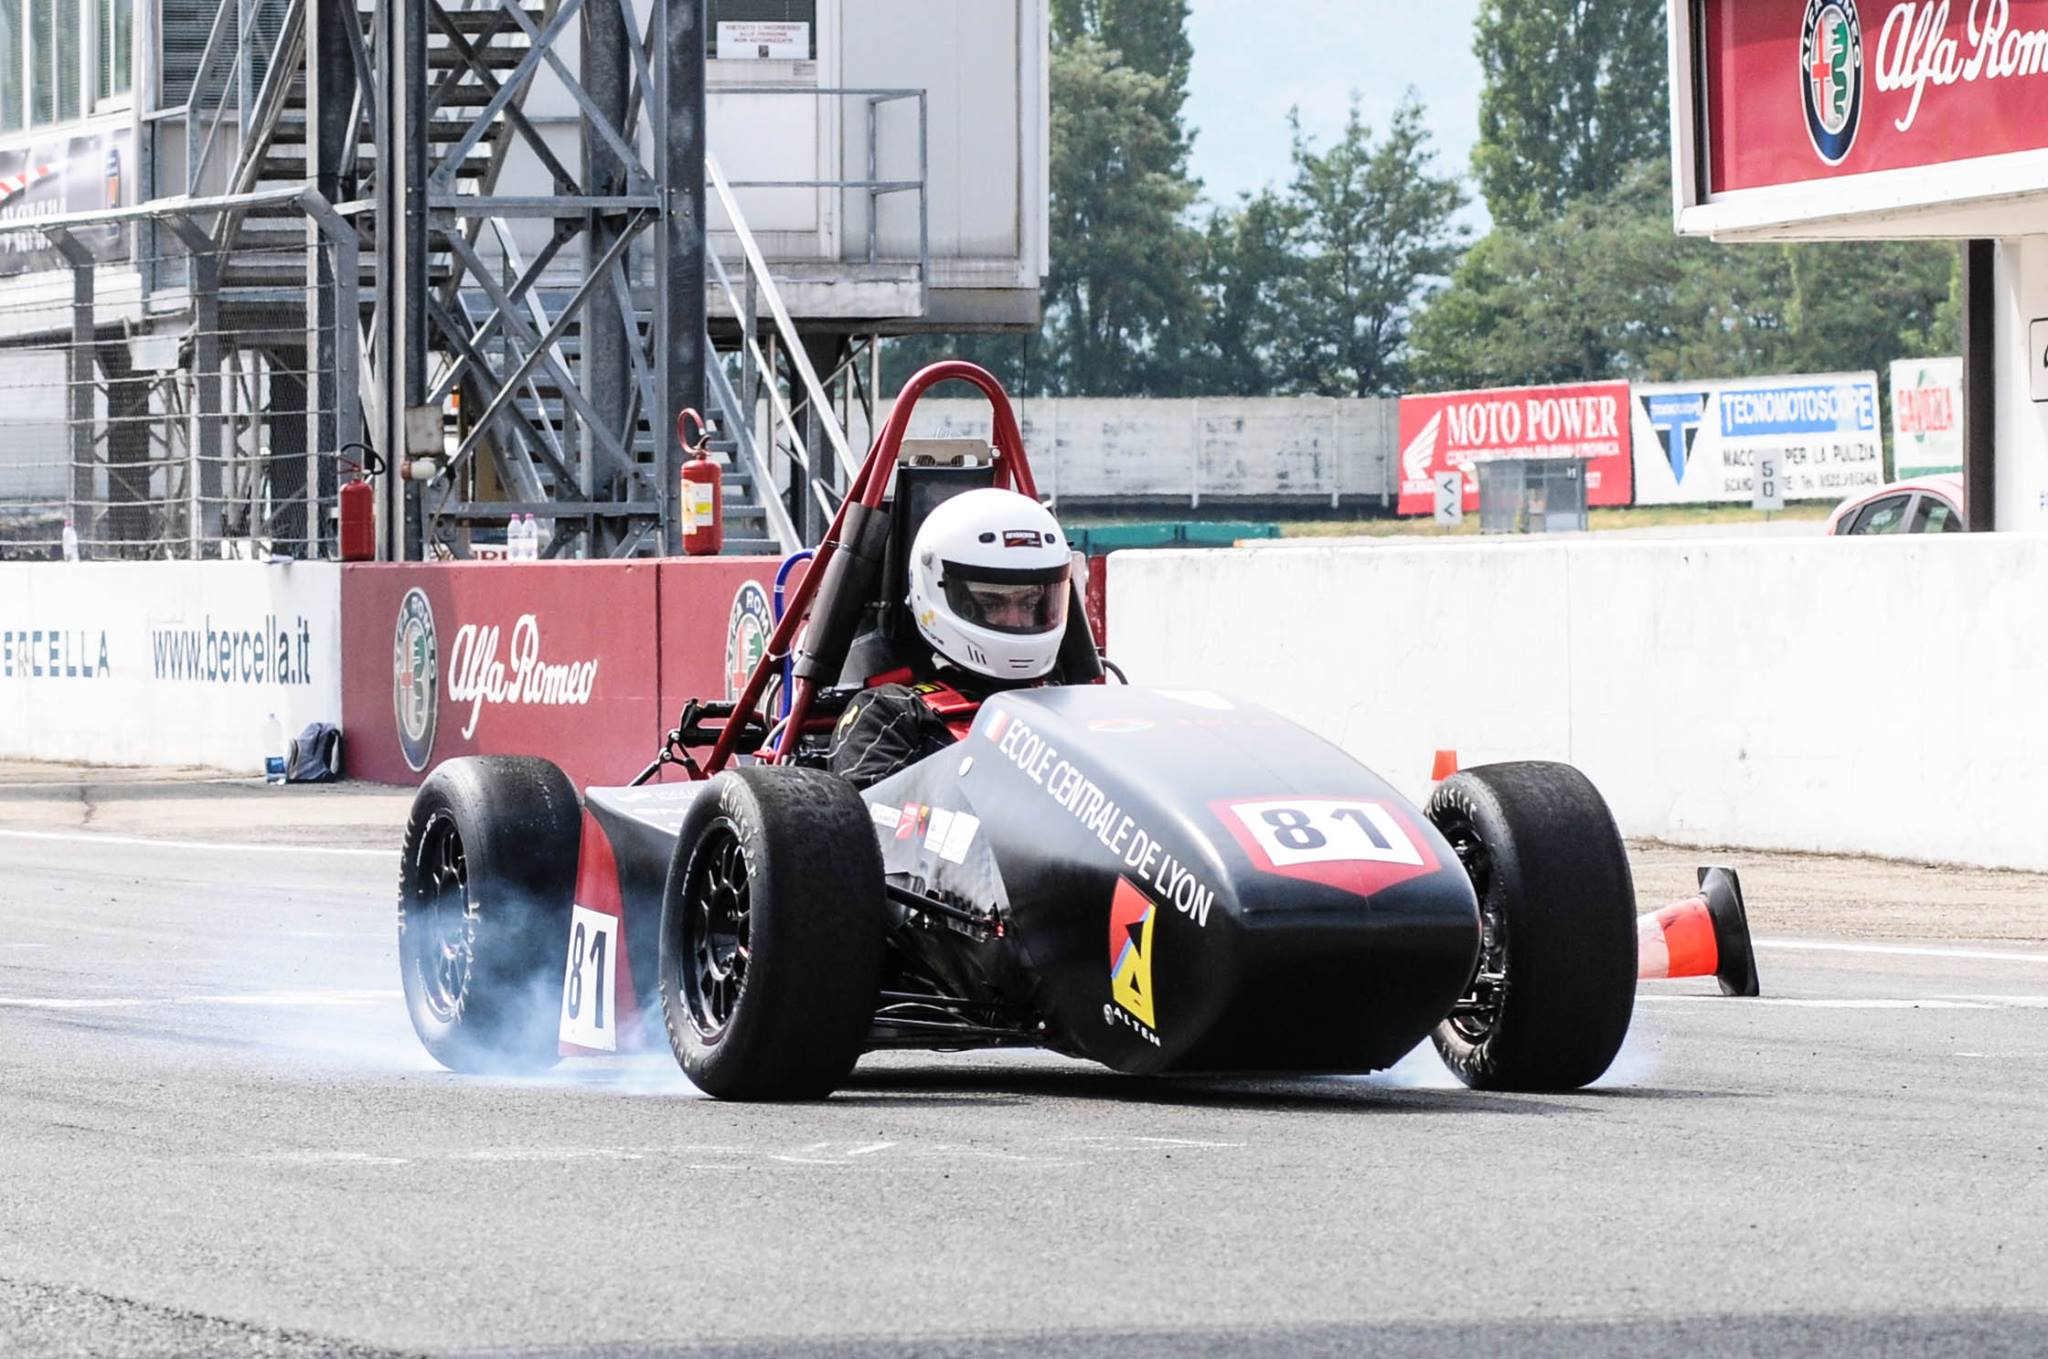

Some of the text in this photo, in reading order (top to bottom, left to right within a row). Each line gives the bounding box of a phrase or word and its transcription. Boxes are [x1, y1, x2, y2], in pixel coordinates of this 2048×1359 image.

[1875, 0, 1965, 132] Alfa
[1446, 395, 1619, 446] MOTO POWER
[1784, 447, 1807, 465] PER
[152, 613, 311, 685] www.bercella.it
[447, 613, 599, 740] Alfa Romeo
[999, 718, 1215, 928] ECOLE CENTRALE DE LYON
[1259, 807, 1394, 851] 81
[567, 921, 608, 1030] 81
[1113, 1006, 1162, 1048] ALTEN
